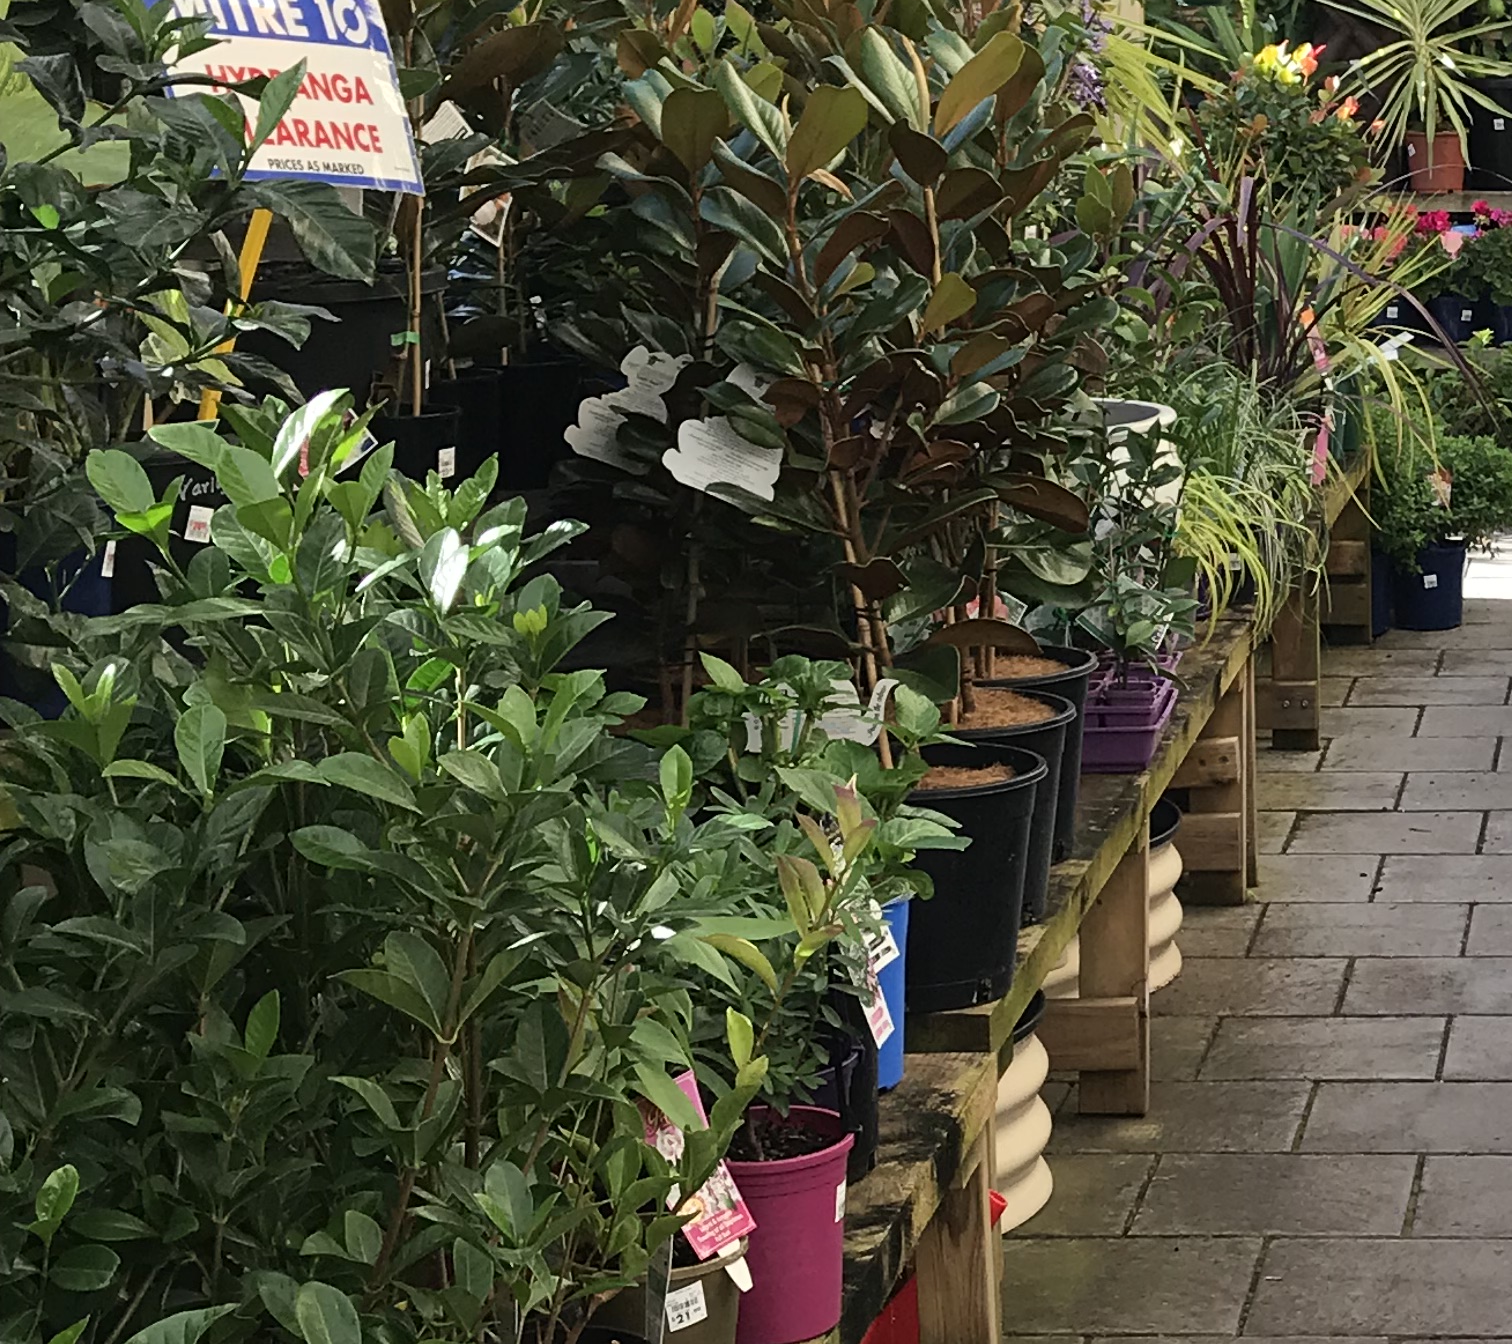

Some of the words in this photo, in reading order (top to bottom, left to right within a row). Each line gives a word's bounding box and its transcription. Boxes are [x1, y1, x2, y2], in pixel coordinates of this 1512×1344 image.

[205, 64, 373, 105] HYANGA
[244, 116, 383, 153] ARANCE
[267, 159, 304, 171] PRICES
[307, 160, 320, 171] AS
[322, 161, 364, 175] MARKED
